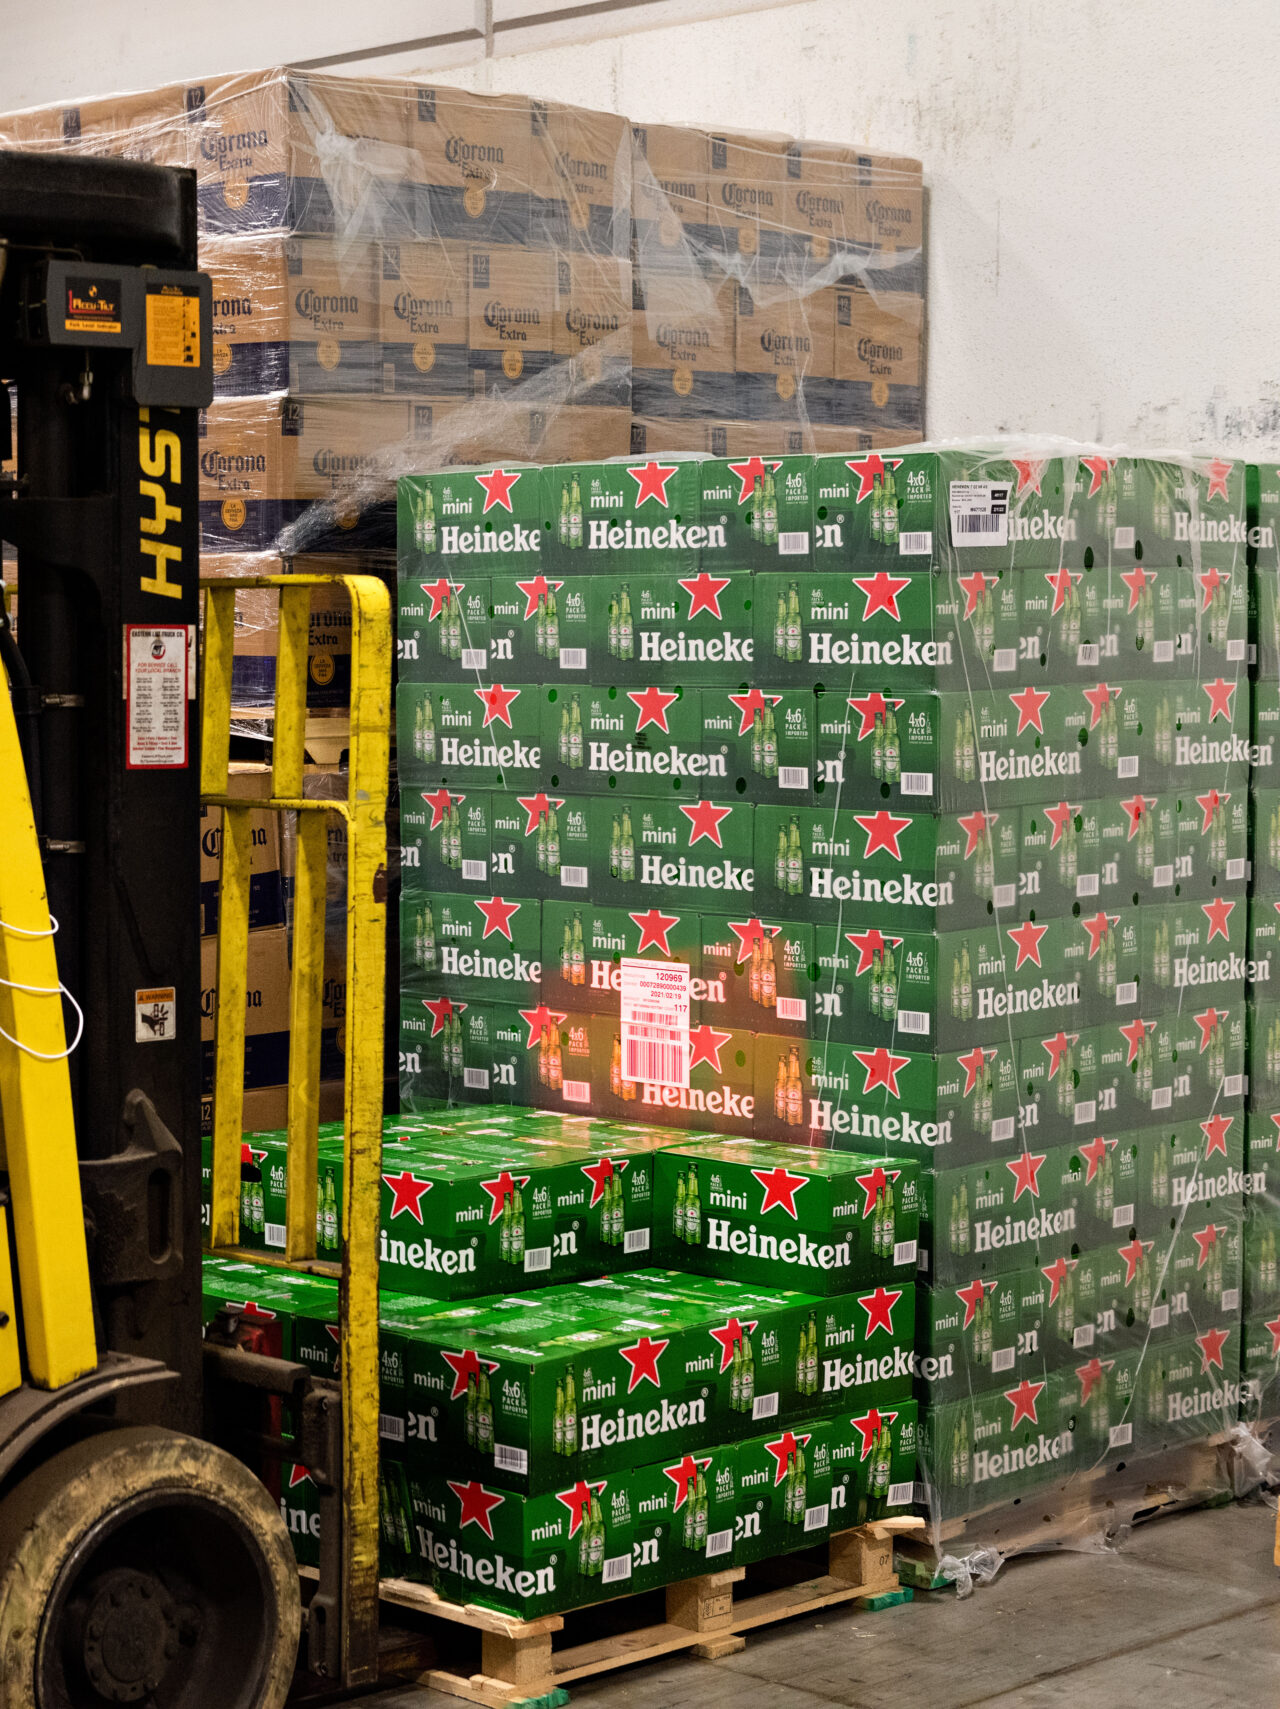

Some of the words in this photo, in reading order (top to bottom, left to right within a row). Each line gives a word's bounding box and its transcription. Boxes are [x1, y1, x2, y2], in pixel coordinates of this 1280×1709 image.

[201, 128, 267, 160] Corona
[445, 135, 504, 166] Corona
[722, 182, 773, 208] Corona
[796, 190, 844, 215] Corona
[866, 200, 911, 224] Corona
[295, 289, 358, 320] Corona
[394, 292, 453, 320] Corona
[484, 300, 540, 328] Corona
[566, 307, 618, 334] Corona
[313, 316, 344, 331] Extra
[410, 319, 439, 335] Extra
[499, 323, 527, 341] Extra
[656, 323, 709, 348] Corona
[761, 328, 810, 353] Corona
[671, 348, 696, 362] Extra
[858, 338, 902, 362] Corona
[870, 363, 891, 376] Extra
[201, 450, 265, 481] Corona
[218, 478, 249, 491] Extra
[786, 473, 802, 488] 4x6
[820, 484, 849, 498] mini
[443, 498, 472, 514] mini
[591, 493, 624, 508] mini
[588, 519, 726, 549] Heineken
[401, 604, 423, 616] mini
[641, 603, 675, 619] mini
[809, 632, 952, 665] Heineken
[591, 715, 623, 730] mini
[785, 708, 802, 723] 4x6
[909, 712, 926, 728] 4x6
[821, 720, 850, 735] mini
[588, 742, 727, 776] Heineken
[980, 737, 1082, 782] Heineken
[404, 812, 425, 825] mini
[495, 817, 519, 830] mini
[810, 868, 953, 906] Heineken
[442, 921, 471, 937] mini
[703, 943, 730, 957] mini
[819, 954, 848, 969] mini
[656, 973, 682, 982] 120969
[674, 1004, 687, 1012] 117
[977, 980, 1080, 1019] Heineken
[496, 1029, 521, 1044] mini
[811, 1070, 849, 1091] mini
[810, 1098, 952, 1146] Heineken
[533, 1186, 547, 1203] 4x6
[558, 1189, 584, 1207] mini
[832, 1200, 858, 1218] mini
[975, 1207, 1076, 1252] Heineken
[707, 1218, 851, 1270] Heineken
[1022, 1291, 1044, 1307] mini
[935, 1312, 958, 1331] mini
[762, 1330, 774, 1347] 4x6
[300, 1346, 328, 1363] mini
[686, 1354, 714, 1373] mini
[581, 1398, 706, 1450] Heineken
[814, 1444, 826, 1461] 4x6
[611, 1489, 625, 1508] 4x6
[638, 1492, 667, 1513] mini
[414, 1497, 445, 1523] mini
[416, 1525, 556, 1597] Heineken
